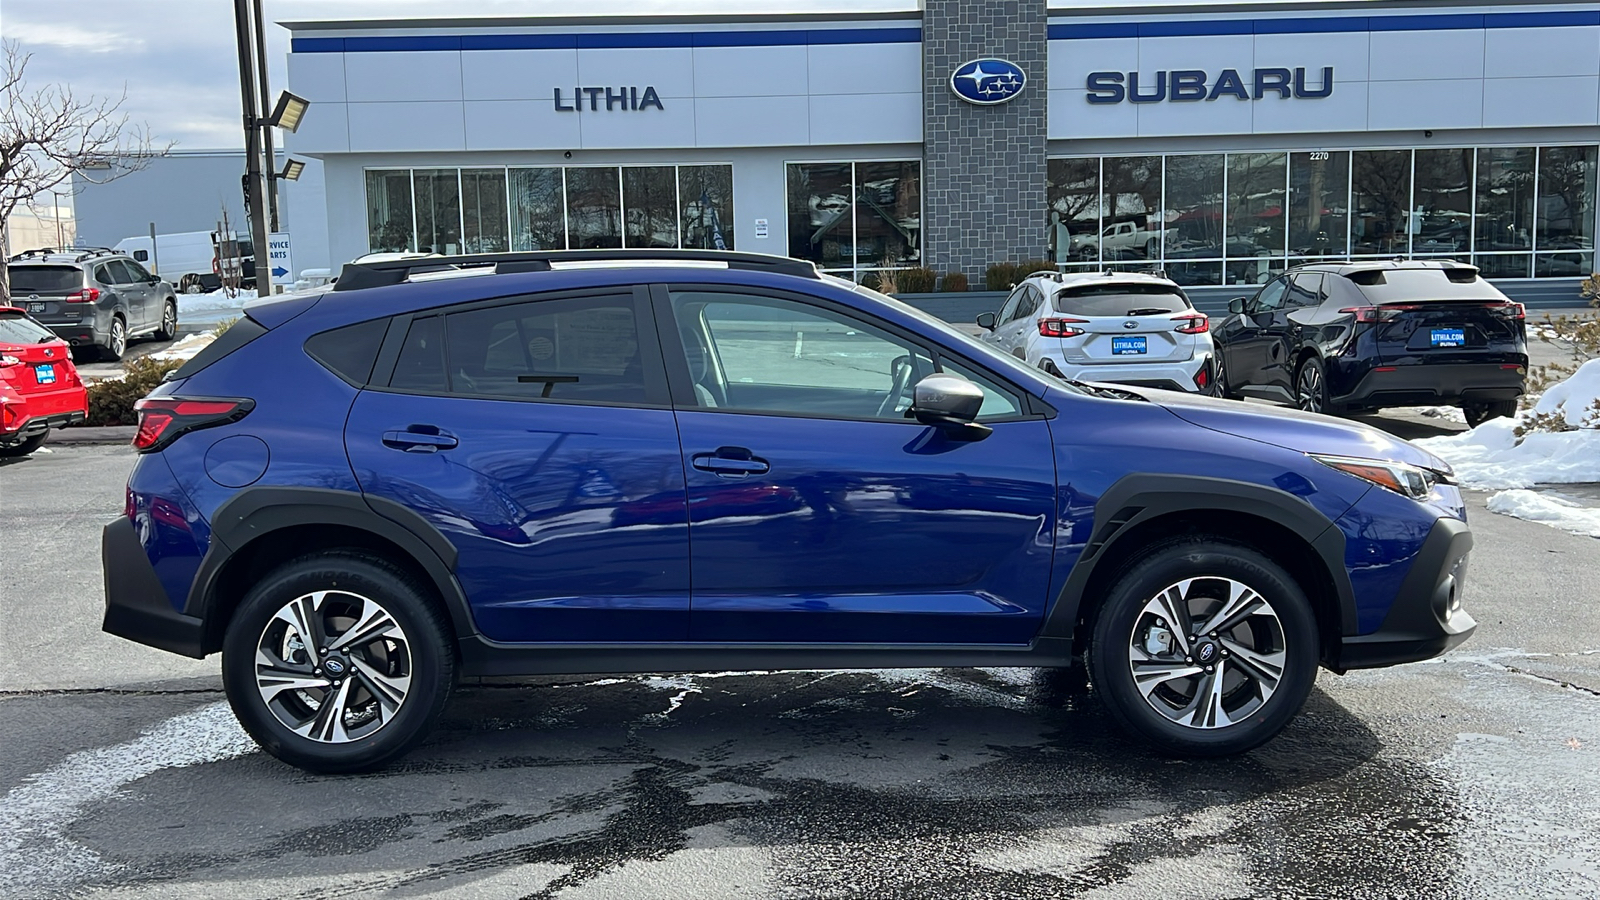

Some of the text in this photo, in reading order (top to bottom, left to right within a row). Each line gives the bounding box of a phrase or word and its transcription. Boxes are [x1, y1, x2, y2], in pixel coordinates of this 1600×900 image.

[1086, 66, 1334, 104] SUBARU
[553, 86, 665, 112] LITHIA
[1309, 151, 1329, 161] 2270
[269, 241, 289, 249] RVICE
[270, 251, 287, 259] ARTS
[1431, 333, 1465, 341] LITHIA.COM
[1113, 341, 1146, 349] LITHIA.COM
